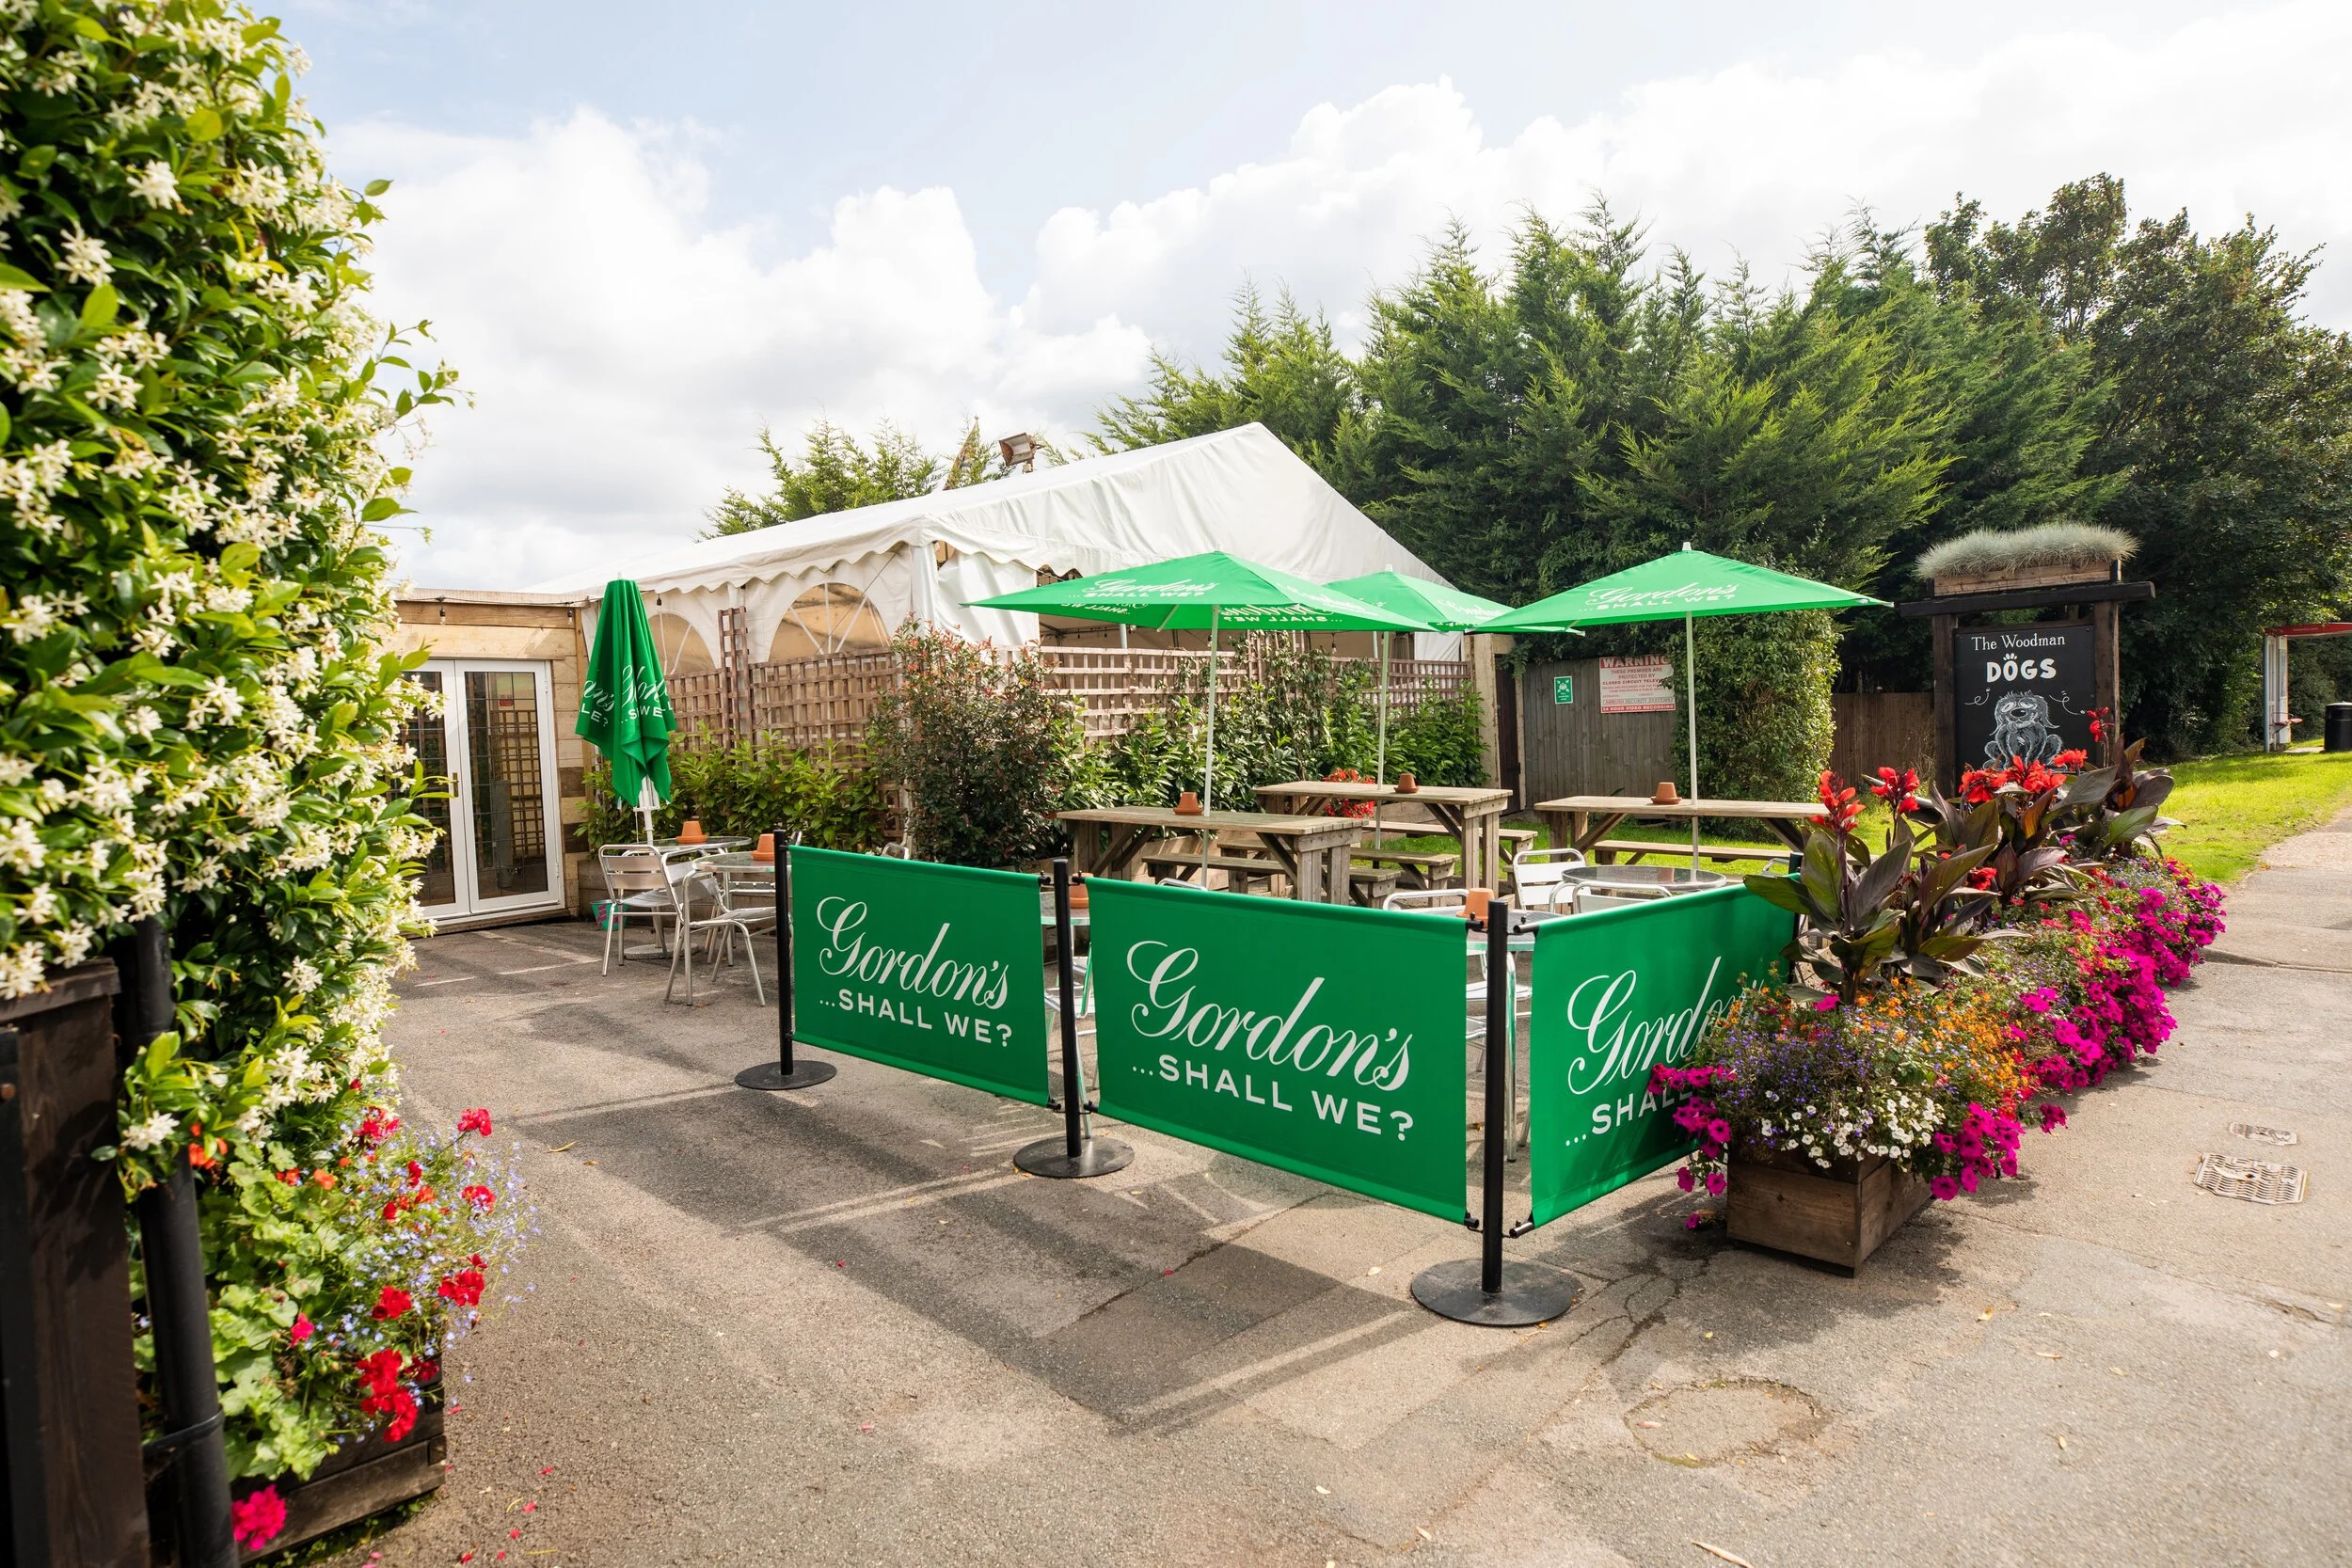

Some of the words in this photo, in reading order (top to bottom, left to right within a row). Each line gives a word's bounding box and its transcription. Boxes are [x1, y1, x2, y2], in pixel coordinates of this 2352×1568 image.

[1082, 578, 1220, 593] Gordon's
[1585, 581, 1740, 606] Gordon's
[1971, 636, 1997, 651] The
[2000, 633, 2066, 649] Woodman
[1986, 657, 2058, 683] DOGS
[816, 896, 1009, 1010] Gordon's
[819, 989, 933, 1030] ...SHALL
[944, 1011, 1013, 1048] WE?
[1126, 941, 1413, 1091] Gordon's
[1132, 1053, 1293, 1112] ...SHALL
[1311, 1089, 1414, 1142] WE?
